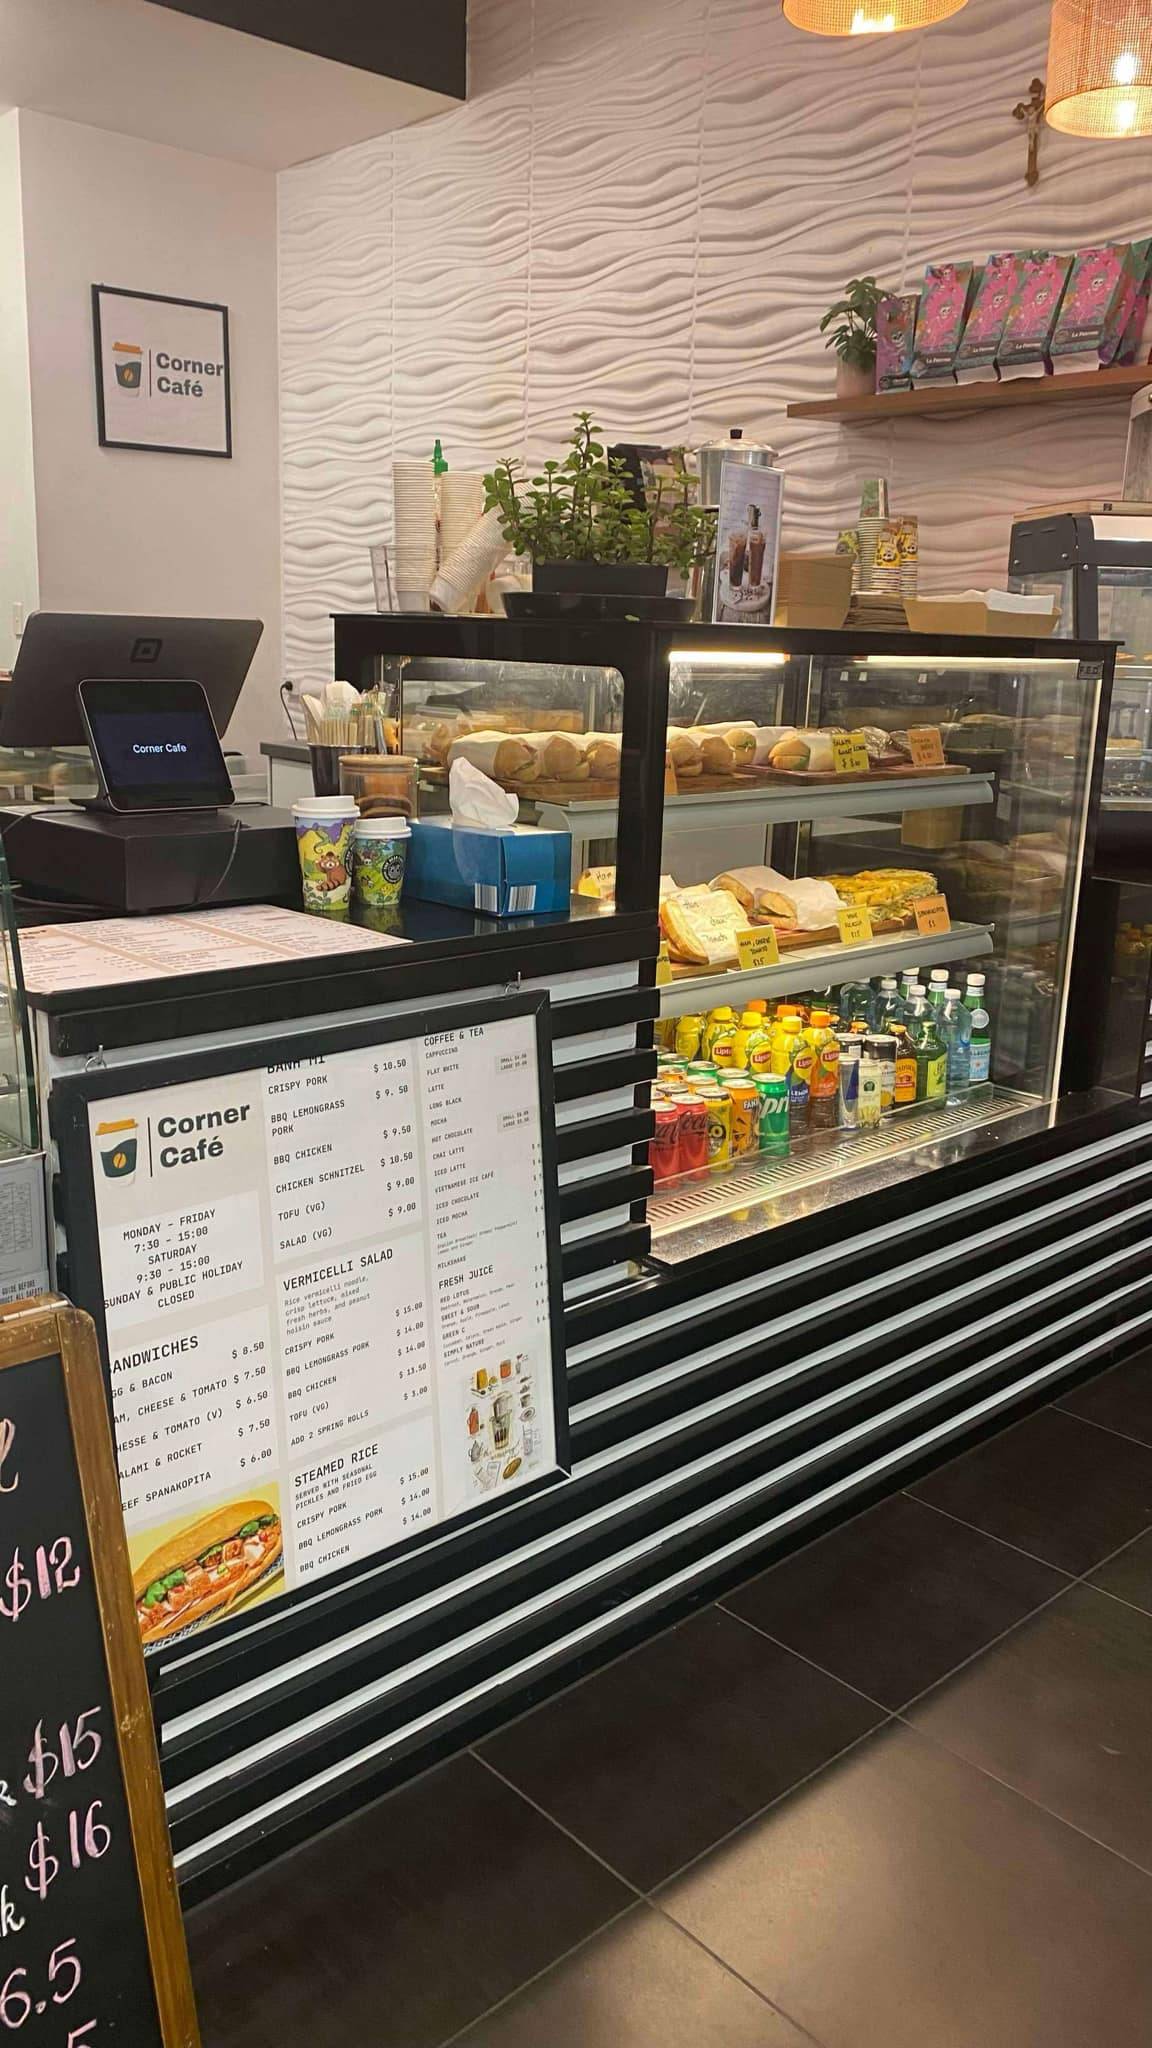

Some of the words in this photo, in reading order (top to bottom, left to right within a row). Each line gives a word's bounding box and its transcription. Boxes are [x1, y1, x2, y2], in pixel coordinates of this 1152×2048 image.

[156, 353, 223, 376] Corner
[157, 377, 203, 397] Café
[133, 744, 163, 753] Corner
[166, 743, 186, 752] Cafe
[424, 1033, 454, 1046] COFFEE
[459, 1031, 464, 1039] &
[469, 1028, 484, 1038] TEA
[426, 1047, 458, 1059] CAPPUCCINO
[383, 1058, 407, 1070] 10.50
[427, 1067, 440, 1076] FLAT
[443, 1064, 459, 1072] WHITE
[268, 1080, 301, 1094] CRISPY
[306, 1075, 328, 1087] PORK
[428, 1084, 444, 1093] LATTE
[271, 1112, 287, 1124] BBQ
[292, 1100, 345, 1119] LEMONGRASS
[429, 1100, 442, 1110] LONG
[446, 1098, 462, 1106] BLACK
[158, 1104, 250, 1138] Corner
[272, 1124, 294, 1137] PORK
[392, 1125, 412, 1136] 9.50
[431, 1117, 447, 1127] MOCHA
[444, 1128, 473, 1140] CHOCOLATE
[160, 1136, 224, 1168] Café
[274, 1154, 290, 1165] BBQ
[295, 1144, 332, 1160] CHICKEN
[389, 1152, 413, 1164] 10.50
[433, 1151, 446, 1160] CHAI
[449, 1146, 464, 1156] LATTE
[276, 1175, 314, 1194] CHICKEN
[319, 1164, 365, 1183] SCHNITZEL
[434, 1168, 447, 1176] ICED
[450, 1163, 466, 1172] LATTE
[396, 1176, 415, 1188] 9.00
[435, 1180, 466, 1194] VIETNAMESE
[278, 1209, 300, 1221] TOFU
[306, 1201, 326, 1214] (VG)
[397, 1202, 416, 1214] 9.00
[436, 1201, 448, 1210] ICED
[451, 1192, 479, 1206] CHOCOLATE
[123, 1223, 161, 1240] MONDAY
[180, 1209, 216, 1226] FRIDAY
[452, 1210, 468, 1220] MOCHA
[134, 1240, 160, 1254] 7:30
[178, 1226, 208, 1242] 15:00
[280, 1235, 307, 1249] SALAD
[312, 1227, 332, 1241] (VG)
[148, 1244, 198, 1265] SATURDAY
[136, 1269, 162, 1284] 9:30
[180, 1255, 210, 1272] 15:00
[283, 1261, 353, 1291] VERMICELLI
[360, 1248, 393, 1268] SALAD
[438, 1274, 464, 1290] FRESH
[469, 1265, 494, 1280] JUICE
[104, 1290, 141, 1309] SUNDAY
[147, 1286, 153, 1296] &
[159, 1274, 196, 1292] PUBLIC
[202, 1260, 243, 1280] HOLIDAY
[285, 1297, 300, 1306] Rice
[304, 1283, 341, 1300] vermicelli
[158, 1290, 195, 1308] CLOSED
[286, 1306, 304, 1316] crisp
[308, 1296, 336, 1308] lettuce,
[341, 1287, 360, 1298] mixed
[403, 1302, 423, 1314] 15.00
[286, 1315, 305, 1326] fresh
[309, 1308, 330, 1318] herbs,
[335, 1301, 345, 1310] and
[349, 1293, 370, 1306] peanut
[287, 1323, 310, 1336] hoisin
[313, 1316, 332, 1326] sauce
[404, 1322, 424, 1334] 14.00
[242, 1341, 265, 1356] 8.50
[285, 1340, 312, 1355] CRISPY
[317, 1333, 334, 1344] PORK
[406, 1341, 425, 1354] 14.00
[110, 1335, 199, 1374] ANDWICHES
[286, 1366, 300, 1376] BBQ
[304, 1349, 348, 1370] LEMONGRASS
[352, 1341, 369, 1352] PORK
[244, 1366, 266, 1380] 7.50
[407, 1363, 427, 1376] 13.50
[129, 1383, 136, 1392] &
[142, 1371, 173, 1388] BACON
[288, 1389, 302, 1399] BBQ
[306, 1376, 337, 1393] CHICKEN
[412, 1386, 428, 1397] 3.00
[138, 1397, 174, 1416] CHEESE
[180, 1393, 186, 1402] &
[192, 1379, 227, 1397] TOMATO
[246, 1391, 268, 1404] 6.50
[289, 1410, 308, 1422] TOFU
[312, 1401, 329, 1414] (VG)
[152, 1432, 159, 1440] &
[165, 1417, 200, 1435] TOMATO
[207, 1408, 222, 1422] (V)
[249, 1419, 270, 1433] 7.50
[291, 1435, 304, 1446] ADD
[317, 1420, 344, 1436] SPRING
[347, 1410, 369, 1424] ROLLS
[155, 1458, 161, 1467] &
[167, 1443, 202, 1462] ROCKET
[251, 1449, 272, 1464] 6.00
[295, 1458, 344, 1487] STEAMED
[351, 1443, 378, 1464] RICE
[295, 1486, 319, 1501] SERVED
[323, 1478, 339, 1489] WITH
[342, 1464, 373, 1481] SEASONAL
[408, 1468, 429, 1481] 15.00
[145, 1471, 212, 1502] SPANAKOPITA
[295, 1493, 324, 1510] PICKLES
[327, 1486, 339, 1496] AND
[342, 1478, 362, 1490] FRIED
[366, 1471, 377, 1481] EGG
[410, 1488, 430, 1502] 14.00
[297, 1512, 325, 1528] CRISPY
[329, 1502, 347, 1515] PORK
[411, 1507, 431, 1521] 14.00
[299, 1538, 313, 1550] BBQ
[317, 1517, 361, 1542] LEMONGRASS
[366, 1507, 383, 1520] PORK
[300, 1560, 314, 1572] BBQ
[318, 1544, 350, 1564] CHICKEN
[0, 1536, 80, 1622] $12
[23, 1706, 102, 1799] $15
[24, 1800, 111, 1900] $16
